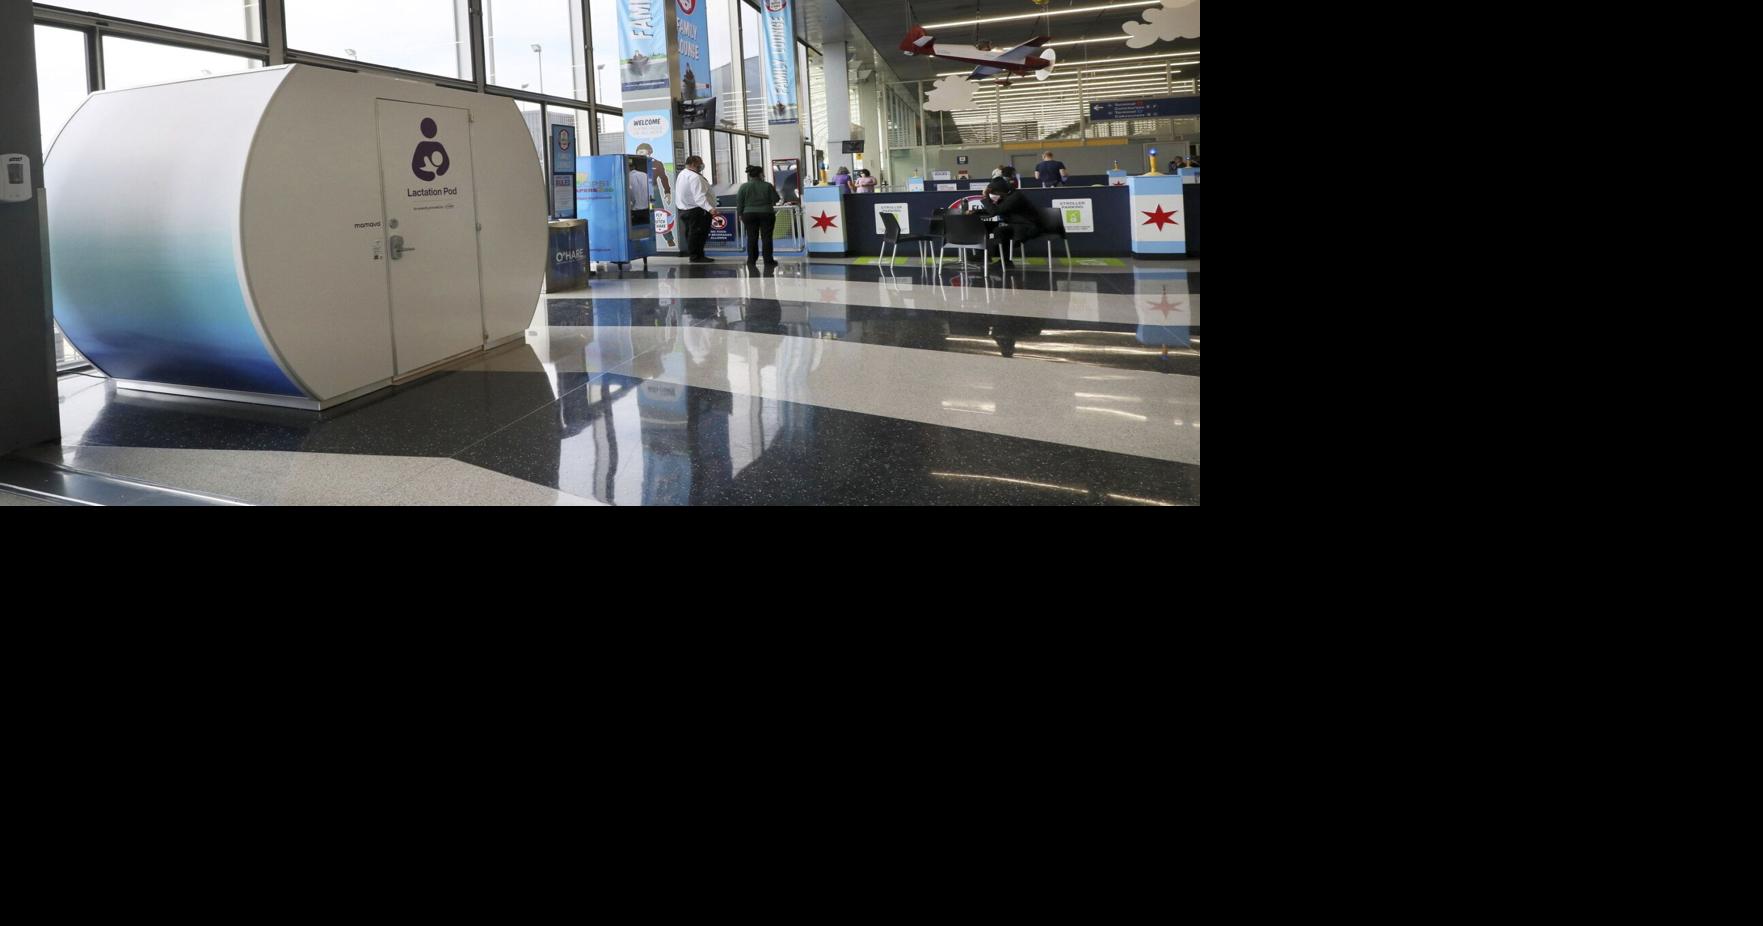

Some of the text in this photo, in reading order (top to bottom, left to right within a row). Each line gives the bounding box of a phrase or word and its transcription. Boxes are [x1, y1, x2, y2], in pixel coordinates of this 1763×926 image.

[770, 15, 789, 96] FAMILY LOUNGE
[633, 118, 661, 127] WELCOME
[407, 186, 458, 198] Lactation Pod
[354, 221, 381, 229] mamava
